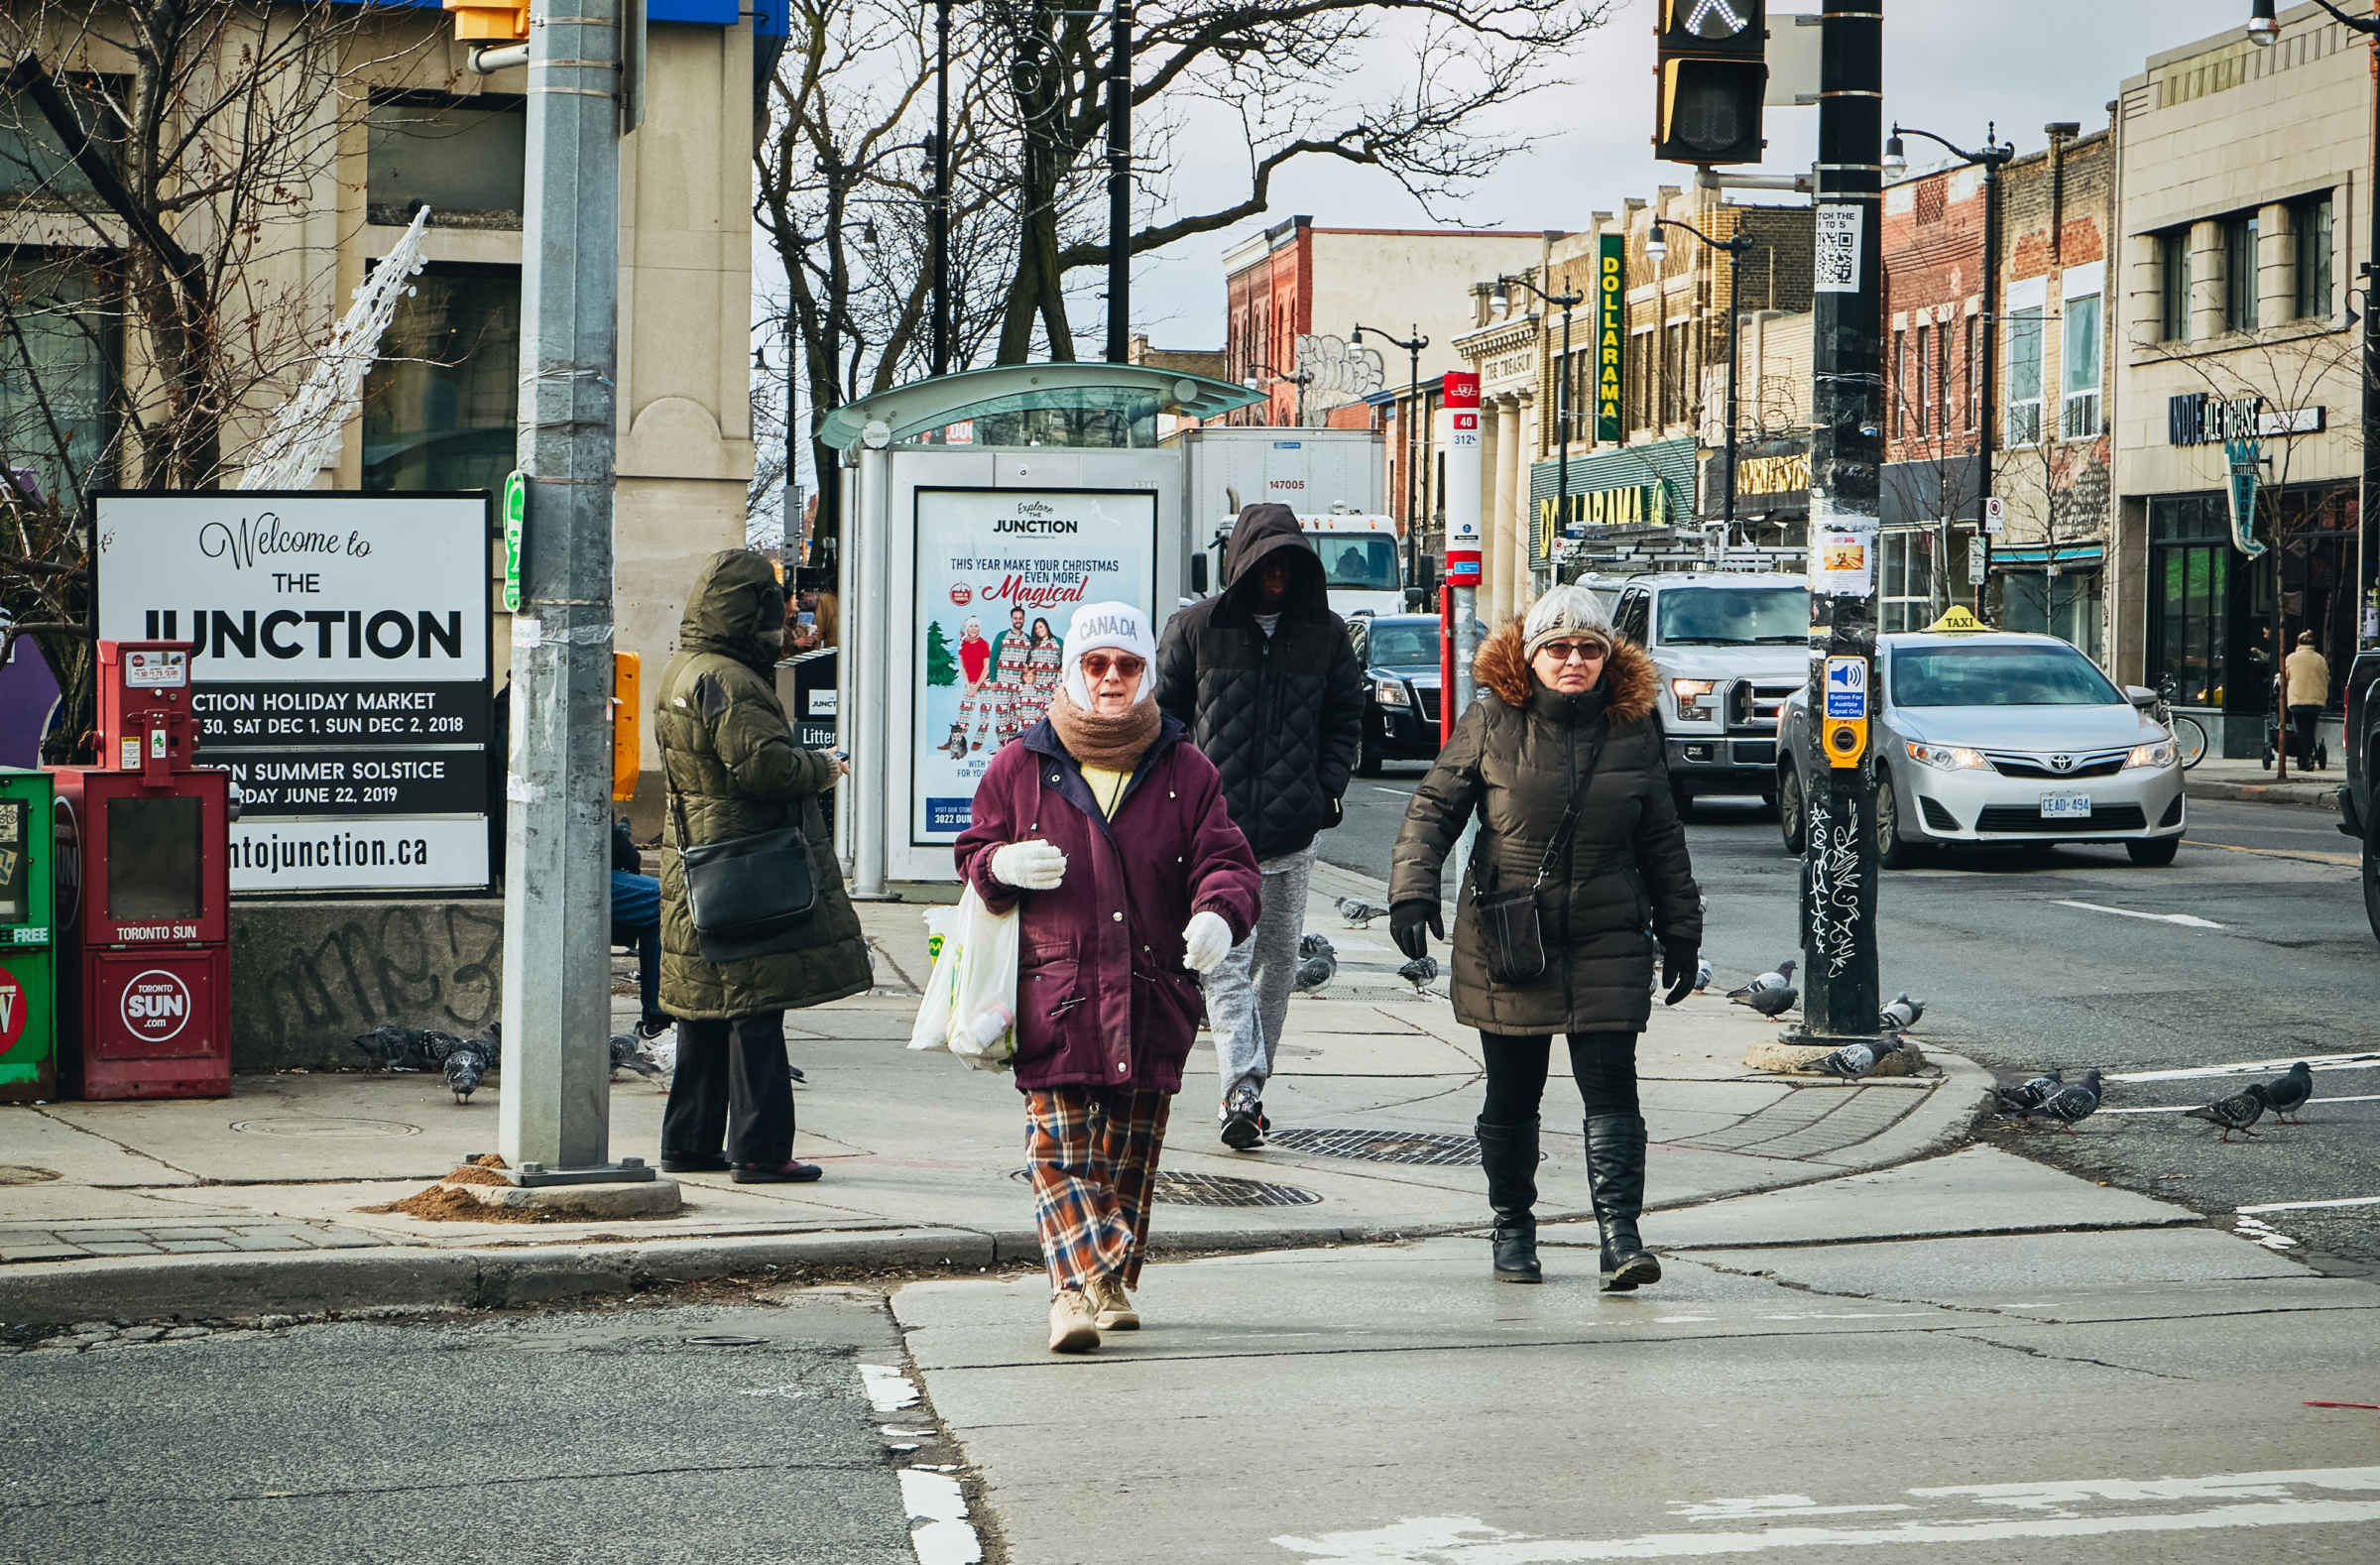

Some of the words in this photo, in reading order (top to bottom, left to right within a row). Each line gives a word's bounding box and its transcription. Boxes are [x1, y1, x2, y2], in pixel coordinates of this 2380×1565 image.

[1601, 256, 1619, 418] DOLLARAMA
[1460, 416, 1473, 426] 40
[2204, 403, 2221, 441] ALE
[2223, 398, 2257, 438] HOUSE
[1269, 480, 1305, 490] 147005
[1017, 501, 1054, 515] Explore
[993, 520, 1078, 534] JUNCTION
[199, 512, 341, 569] Welcome
[347, 530, 372, 558] to
[951, 558, 973, 571] THIS
[977, 558, 1001, 571] YEAR
[1004, 559, 1030, 571] MAKE
[1034, 559, 1059, 571] YOUR
[1062, 559, 1119, 572] CHRISTMAS
[272, 573, 320, 593] THE
[1024, 572, 1049, 583] EVEN
[1052, 572, 1081, 583] MORE
[982, 574, 1089, 609] Magical
[1080, 615, 1137, 642] CANADA
[1946, 618, 1973, 628] TAXI
[191, 693, 255, 711] CTION
[263, 692, 349, 711] HOLIDAY
[357, 692, 436, 710] MARKET
[203, 718, 227, 735] 30,
[233, 718, 262, 734] SAT
[268, 718, 303, 734] DEC
[310, 718, 320, 735] 1,
[326, 718, 363, 734] SUN
[369, 718, 405, 734] DEC
[410, 717, 423, 734] 2,
[428, 717, 464, 733] 2018
[803, 728, 836, 745] Litter
[255, 763, 345, 781] SUMMER
[352, 762, 445, 779] SOLSTICE
[239, 788, 279, 804] RDAY
[285, 787, 330, 803] JUNE
[335, 787, 358, 804] 22,
[363, 786, 398, 802] 2019
[956, 814, 972, 824] DUN
[229, 832, 427, 874] ntojunction.ca
[14, 927, 49, 943] FREE
[116, 926, 170, 941] TORONTO
[173, 925, 197, 939] SUN
[128, 994, 183, 1018] SUN
[144, 1019, 167, 1028] .com
